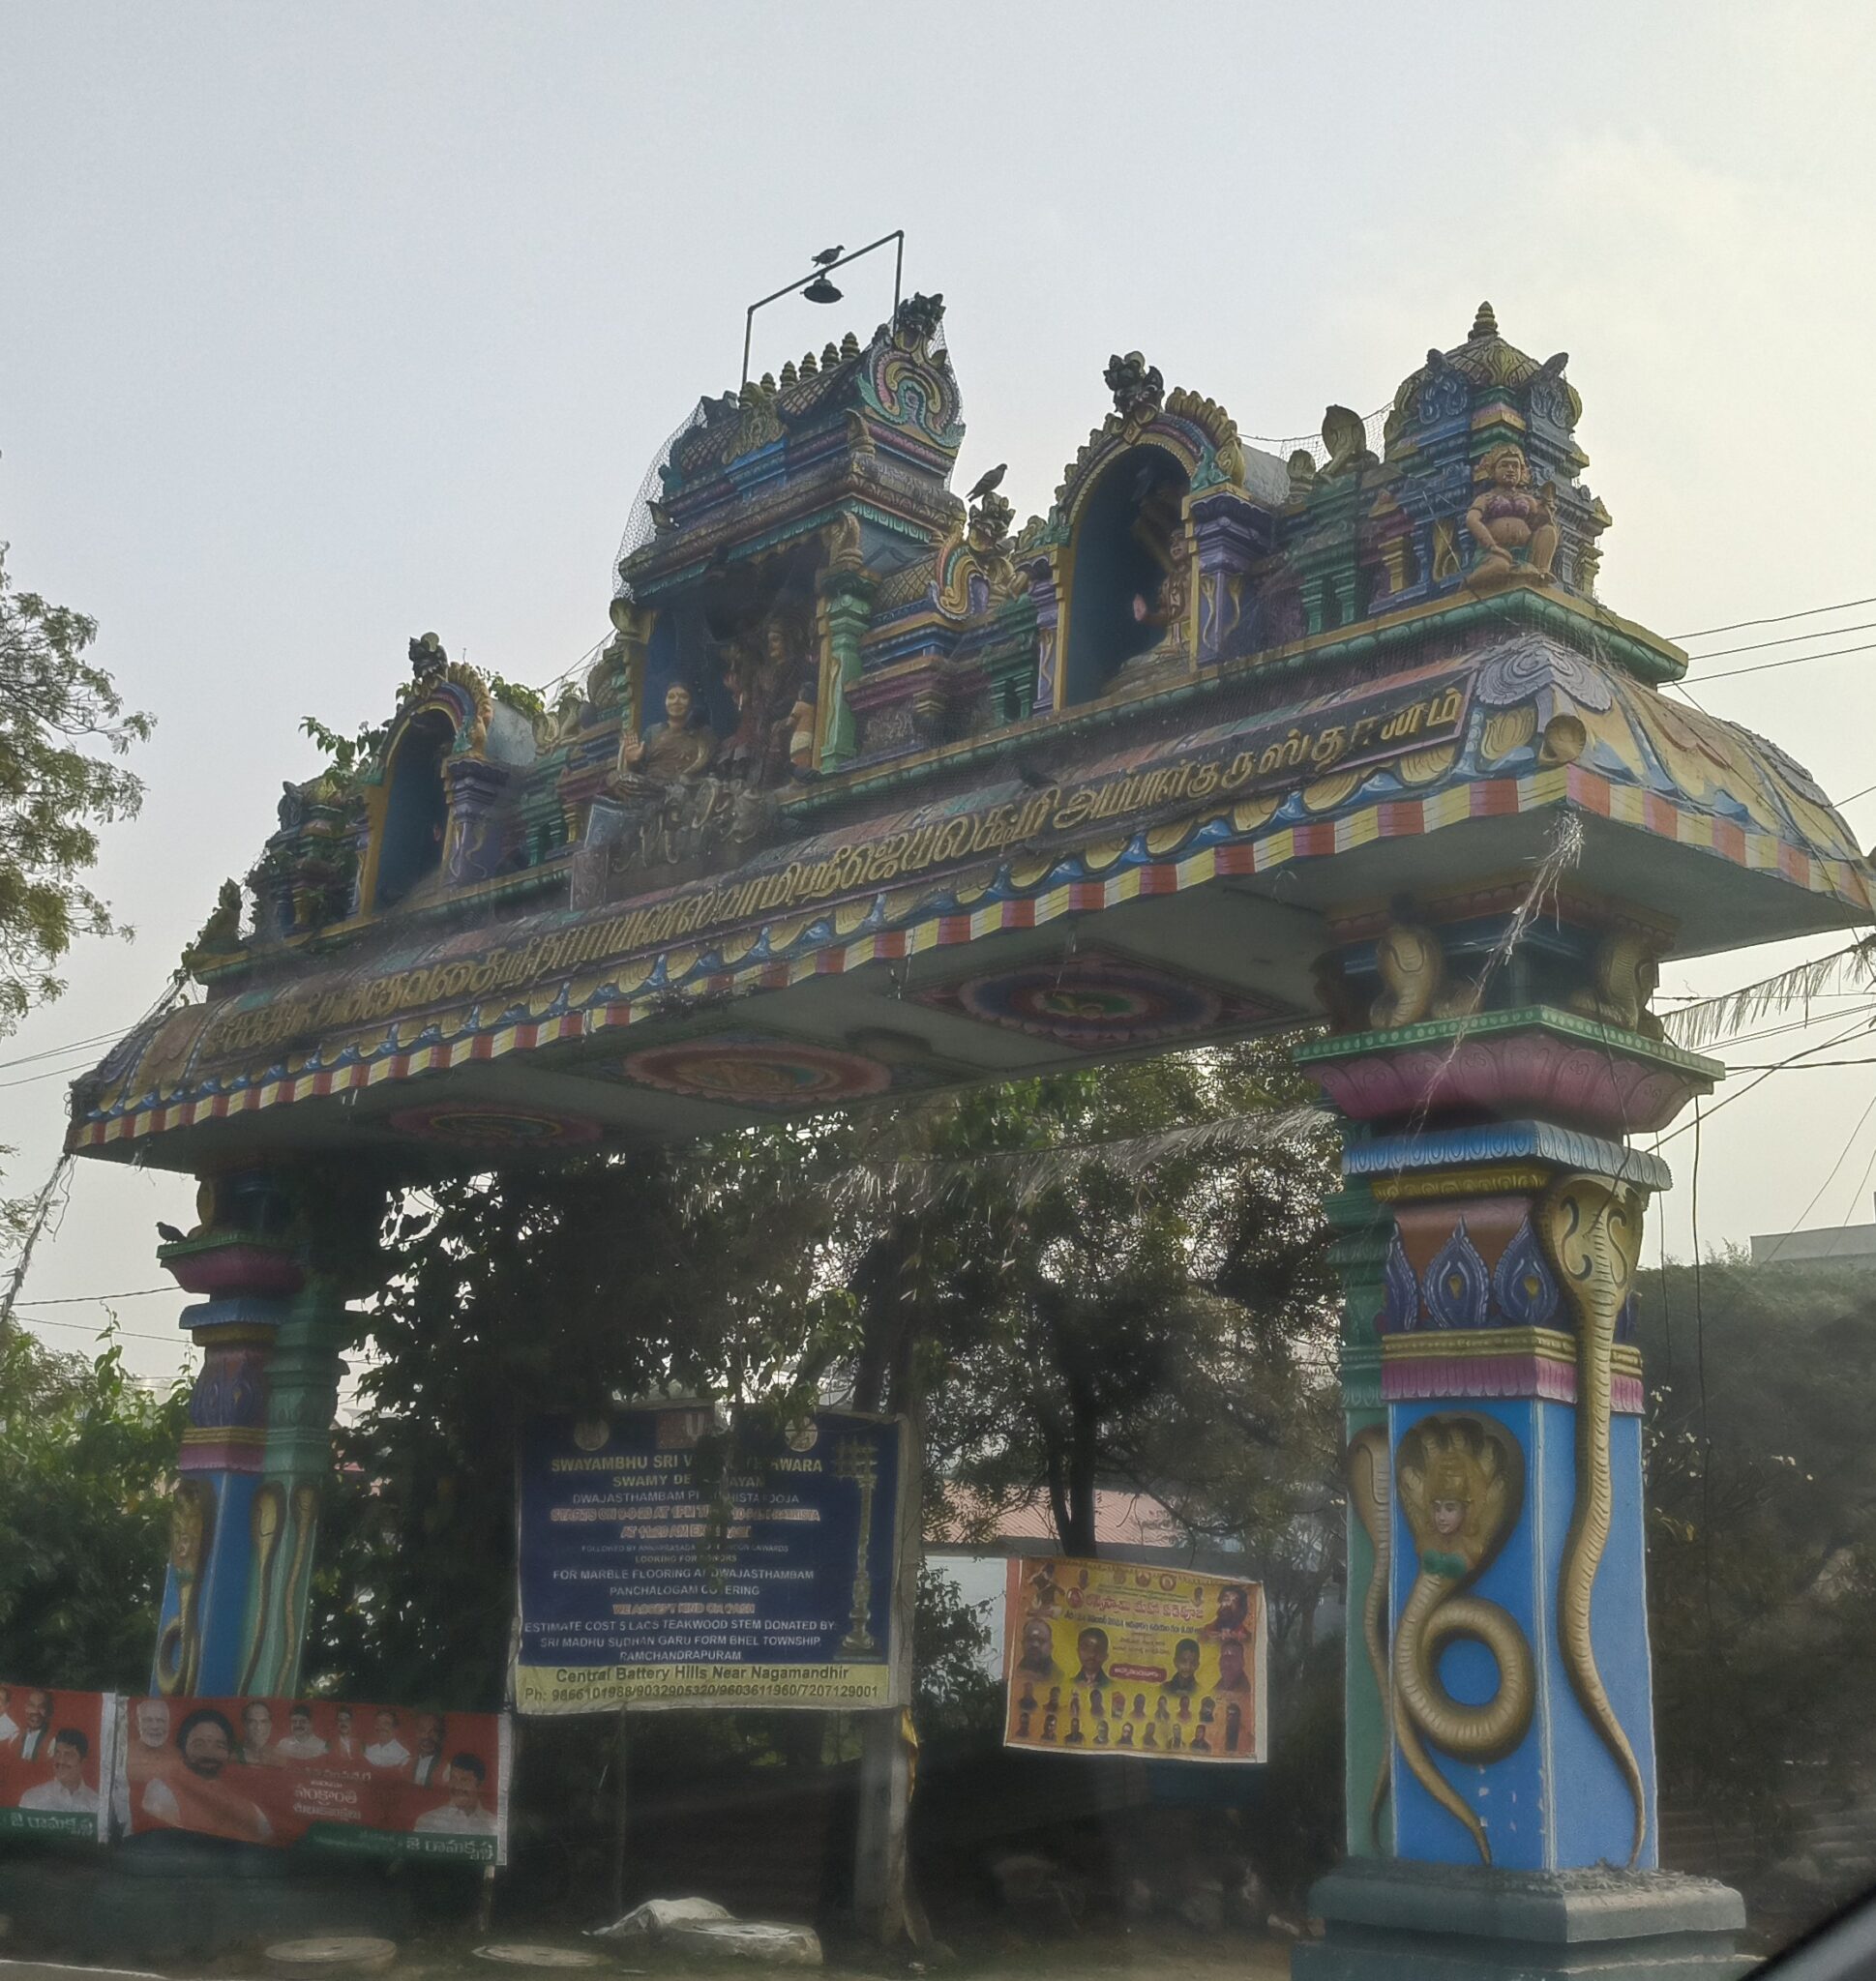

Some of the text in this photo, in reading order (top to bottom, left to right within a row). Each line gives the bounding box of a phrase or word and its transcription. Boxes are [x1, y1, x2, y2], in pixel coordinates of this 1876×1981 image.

[551, 1456, 647, 1472] SWAYAMBHU
[653, 1455, 678, 1468] SRI
[612, 1474, 668, 1487] SWAMY
[573, 1492, 684, 1503] DWAJASTHAMBAM
[679, 1554, 698, 1563] FOR
[552, 1570, 578, 1580] FOR
[581, 1570, 629, 1580] MARBLE
[632, 1569, 691, 1579] FLOORING
[610, 1585, 699, 1596] PANCHALOGAM
[524, 1621, 581, 1633] ESTIMATE
[584, 1620, 616, 1632] COST
[618, 1621, 626, 1631] 5
[629, 1620, 660, 1631] LACS
[663, 1619, 729, 1631] TEAKWOOD
[730, 1619, 761, 1630] STEM
[764, 1620, 818, 1631] DONATED
[540, 1637, 559, 1647] SRI
[562, 1637, 605, 1647] MADHU
[608, 1636, 655, 1647] SUDHAN
[658, 1636, 691, 1646] GARU
[695, 1636, 727, 1645] FORM
[730, 1636, 759, 1645] BHEL
[556, 1665, 849, 1682] Central Battery Hills Near Nagamandhir
[525, 1687, 547, 1701] Ph:
[294, 1784, 357, 1806] సంక్రాంతి
